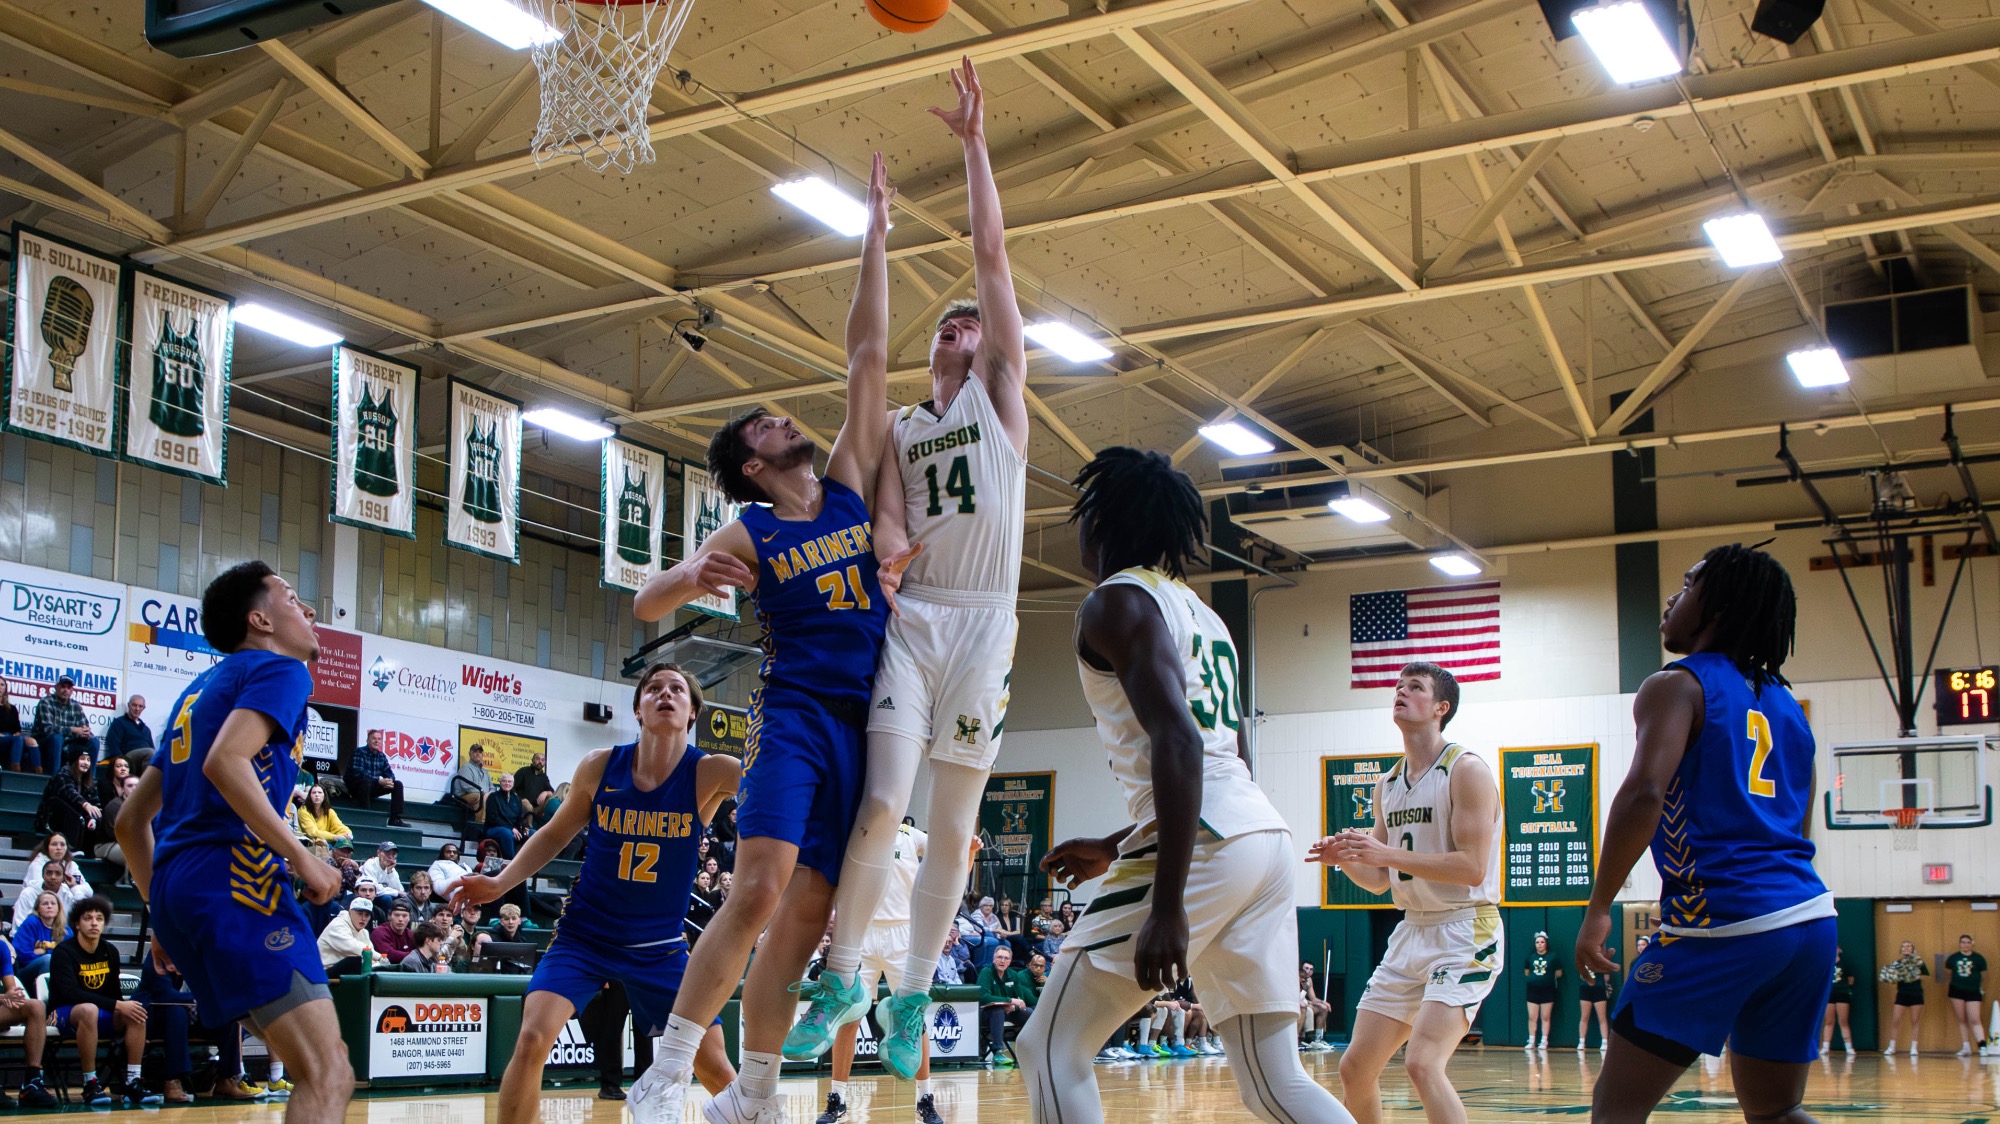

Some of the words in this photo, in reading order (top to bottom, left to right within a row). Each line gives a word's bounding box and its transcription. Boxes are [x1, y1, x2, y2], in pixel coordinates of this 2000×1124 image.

[23, 239, 46, 261] DR.
[48, 247, 117, 286] SULLIVAN
[161, 342, 198, 360] HUSSON
[164, 359, 194, 389] 50
[354, 358, 402, 384] SIEBERT
[18, 388, 29, 402] 25
[32, 391, 57, 409] YEARS
[60, 399, 71, 412] OF
[73, 403, 106, 423] SERVICE
[17, 405, 106, 444] 1972-1997
[362, 411, 391, 427] HUSSON
[364, 424, 388, 452] 20
[907, 421, 981, 464] HUSSON
[153, 438, 199, 466] 1990
[623, 447, 649, 466] ALLEY
[925, 455, 976, 517] 14
[358, 499, 389, 522] 1991
[627, 504, 642, 526] 12
[467, 525, 496, 548] 1993
[815, 564, 871, 611] 21
[13, 585, 102, 619] DYSART'S
[28, 609, 94, 631] Restaurant
[24, 634, 88, 652] dysarts.com
[333, 649, 345, 658] ALL
[330, 658, 345, 668] Estate
[65, 667, 117, 691] MAINE
[327, 679, 335, 687] the
[398, 667, 457, 695] Creative
[462, 664, 522, 695] Wight's
[1186, 632, 1240, 732] 30
[1951, 670, 1995, 691] 6:16
[39, 687, 47, 697] &
[97, 695, 114, 708] CO.
[493, 693, 522, 707] SPORTING
[524, 698, 547, 711] GOODS
[1962, 689, 1989, 718] 17
[171, 689, 203, 764] 5
[473, 706, 535, 726] 1-800-205-TEAM
[307, 724, 335, 742] STREET
[1533, 753, 1562, 765] NCAA
[1747, 708, 1776, 798] 2
[402, 765, 434, 775] Entertainment
[434, 769, 450, 777] Center
[1354, 762, 1380, 773] NCAA
[1511, 764, 1585, 778] TOURNAMENT
[597, 804, 693, 838] MARINERS
[1386, 807, 1433, 828] HUSSON
[1520, 821, 1577, 834] SOFTBALL
[1509, 843, 1532, 852] 2009
[1538, 842, 1560, 851] 2010
[1567, 842, 1586, 850] 2011
[618, 841, 660, 883] 12
[1005, 858, 1023, 866] 2023
[1510, 855, 1532, 863] 2012
[1538, 854, 1559, 863] 2013
[1566, 853, 1587, 862] 2014
[1511, 866, 1532, 875] 2015
[1538, 865, 1560, 874] 2018
[1566, 865, 1588, 874] 2019
[1510, 878, 1532, 887] 2021
[1537, 877, 1561, 886] 2022
[1566, 876, 1589, 885] 2023
[415, 1003, 481, 1022] DORR'S
[418, 1024, 479, 1032] EQUIPMENT
[930, 1026, 962, 1040] NAC
[406, 1037, 441, 1045] HAMMOND
[442, 1037, 468, 1045] STREET
[392, 1049, 423, 1059] BANGOR,
[425, 1049, 446, 1057] MAINE
[406, 1061, 422, 1071] (207)
[424, 1061, 451, 1069] 945-5965
